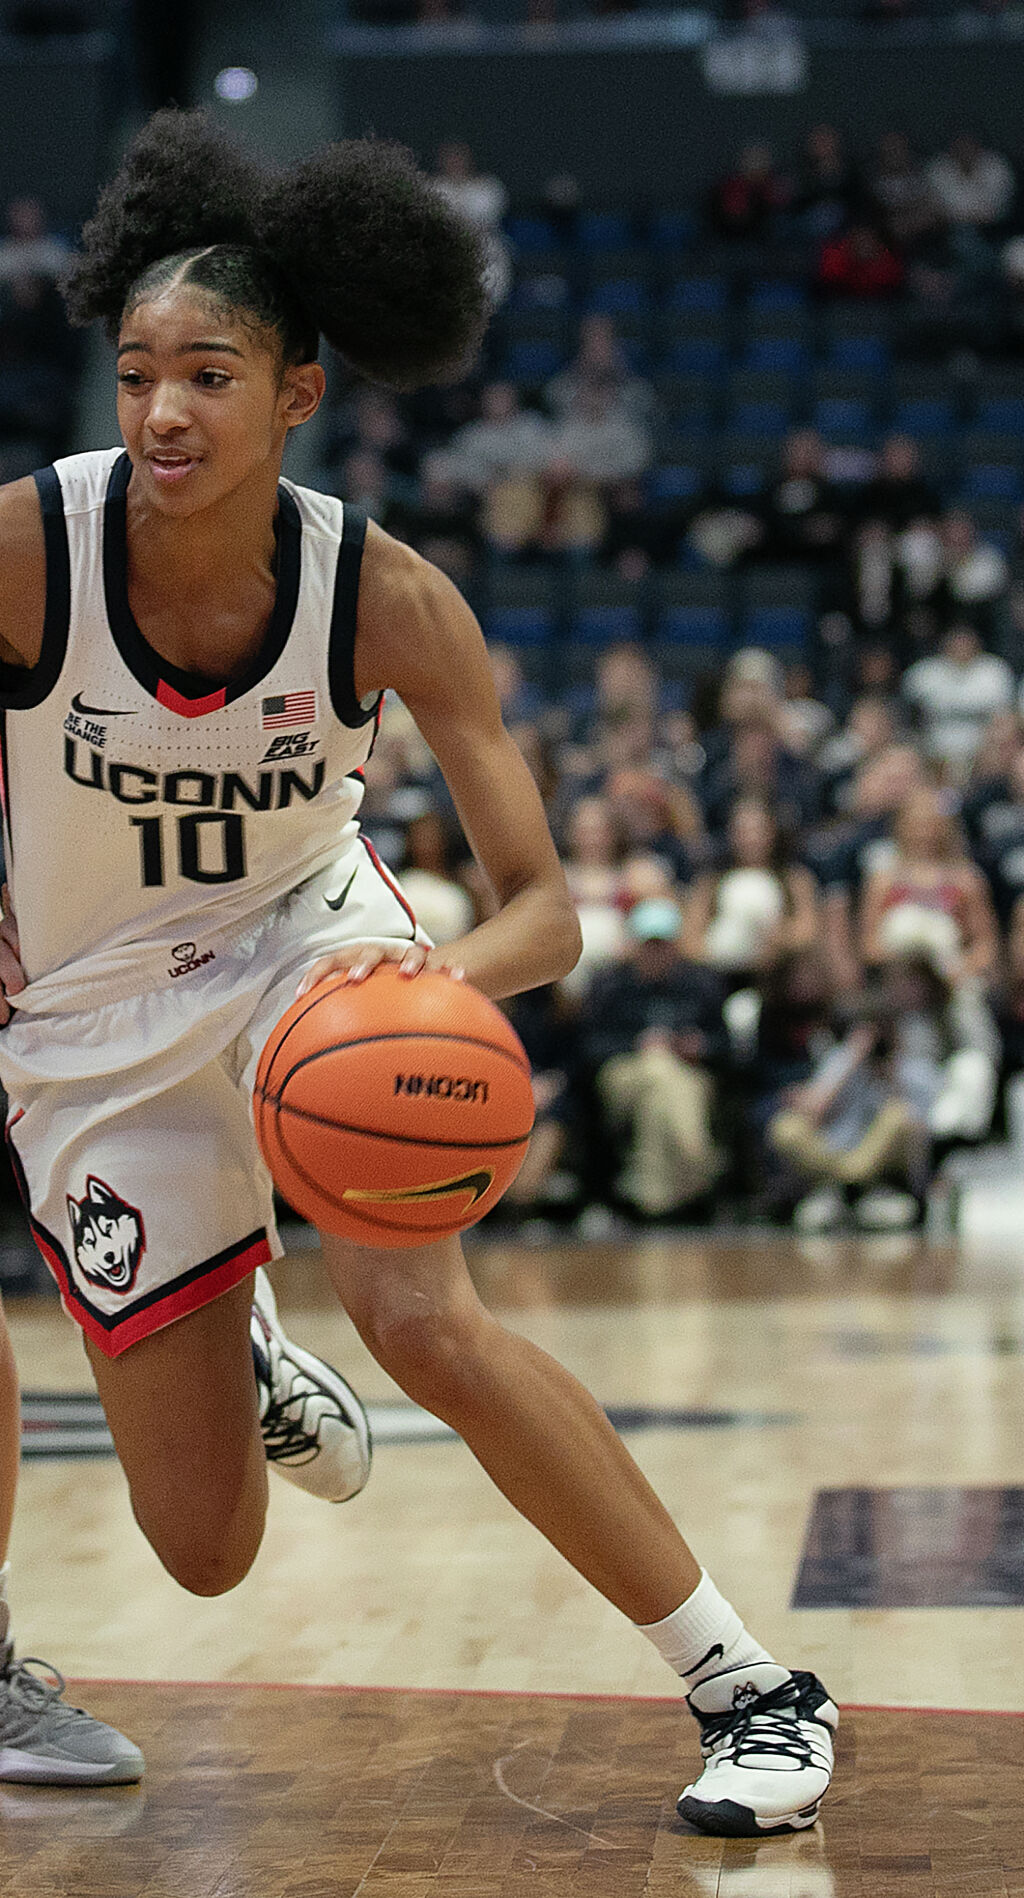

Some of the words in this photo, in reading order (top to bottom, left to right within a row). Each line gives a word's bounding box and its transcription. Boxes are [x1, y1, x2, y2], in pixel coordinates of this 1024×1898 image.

[64, 719, 107, 749] CHANGE
[68, 712, 82, 726] BE
[84, 720, 107, 737] THE
[271, 731, 311, 747] BIG
[264, 739, 320, 757] EAST
[64, 733, 326, 811] UCONN
[129, 811, 248, 888] 10
[167, 950, 216, 978] UCONN
[394, 1073, 489, 1105] UCONN
